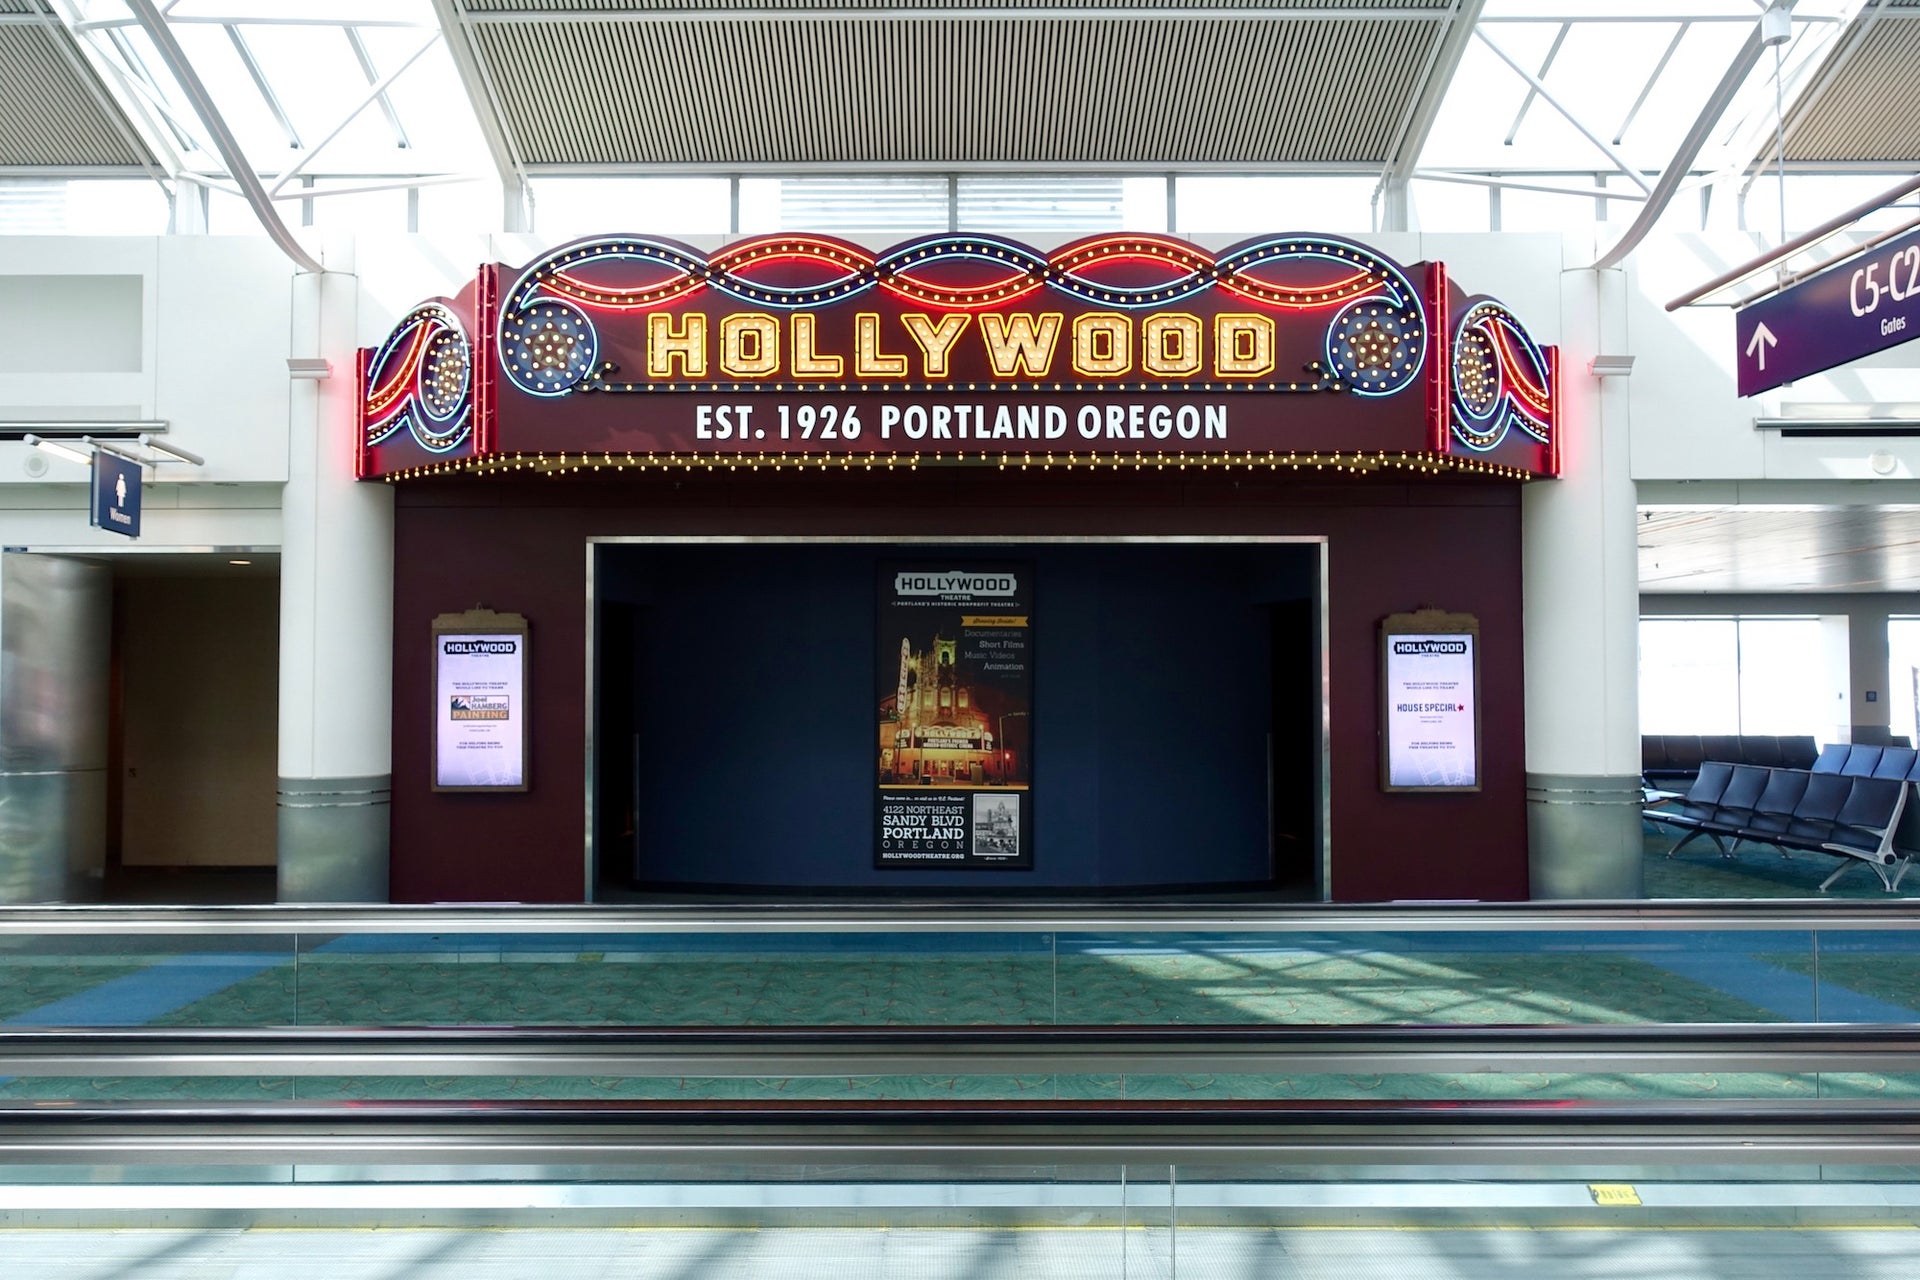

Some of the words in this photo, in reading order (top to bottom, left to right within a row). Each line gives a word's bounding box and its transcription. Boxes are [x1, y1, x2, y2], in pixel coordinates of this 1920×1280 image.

[1881, 316, 1906, 336] Gates
[647, 312, 1276, 378] HOLLYWOOD
[696, 405, 764, 440] EST.
[777, 404, 861, 440] 1926
[881, 405, 1067, 440] PORTLAND
[1077, 404, 1228, 440] OREGON
[109, 506, 132, 525] Women
[901, 577, 1011, 591] HOLLYWOOD
[964, 629, 1022, 638] Documentaries
[446, 643, 514, 653] HOLLYWOOD
[978, 640, 1001, 649] Short
[1003, 640, 1025, 649] Films
[1396, 643, 1464, 653] HOLLYWOOD
[964, 651, 987, 660] Music
[989, 651, 1016, 660] Videos
[983, 662, 1025, 671] Animation
[1397, 703, 1423, 712] HOUSE
[1424, 703, 1457, 712] SPECIAL
[452, 711, 508, 719] PAINTING
[883, 806, 904, 814] 4122
[906, 806, 964, 815] NORTHEAST
[883, 815, 927, 827] SANDY
[931, 816, 964, 827] BLVD
[883, 828, 964, 840] PORTLAND
[883, 840, 964, 849] OREGON
